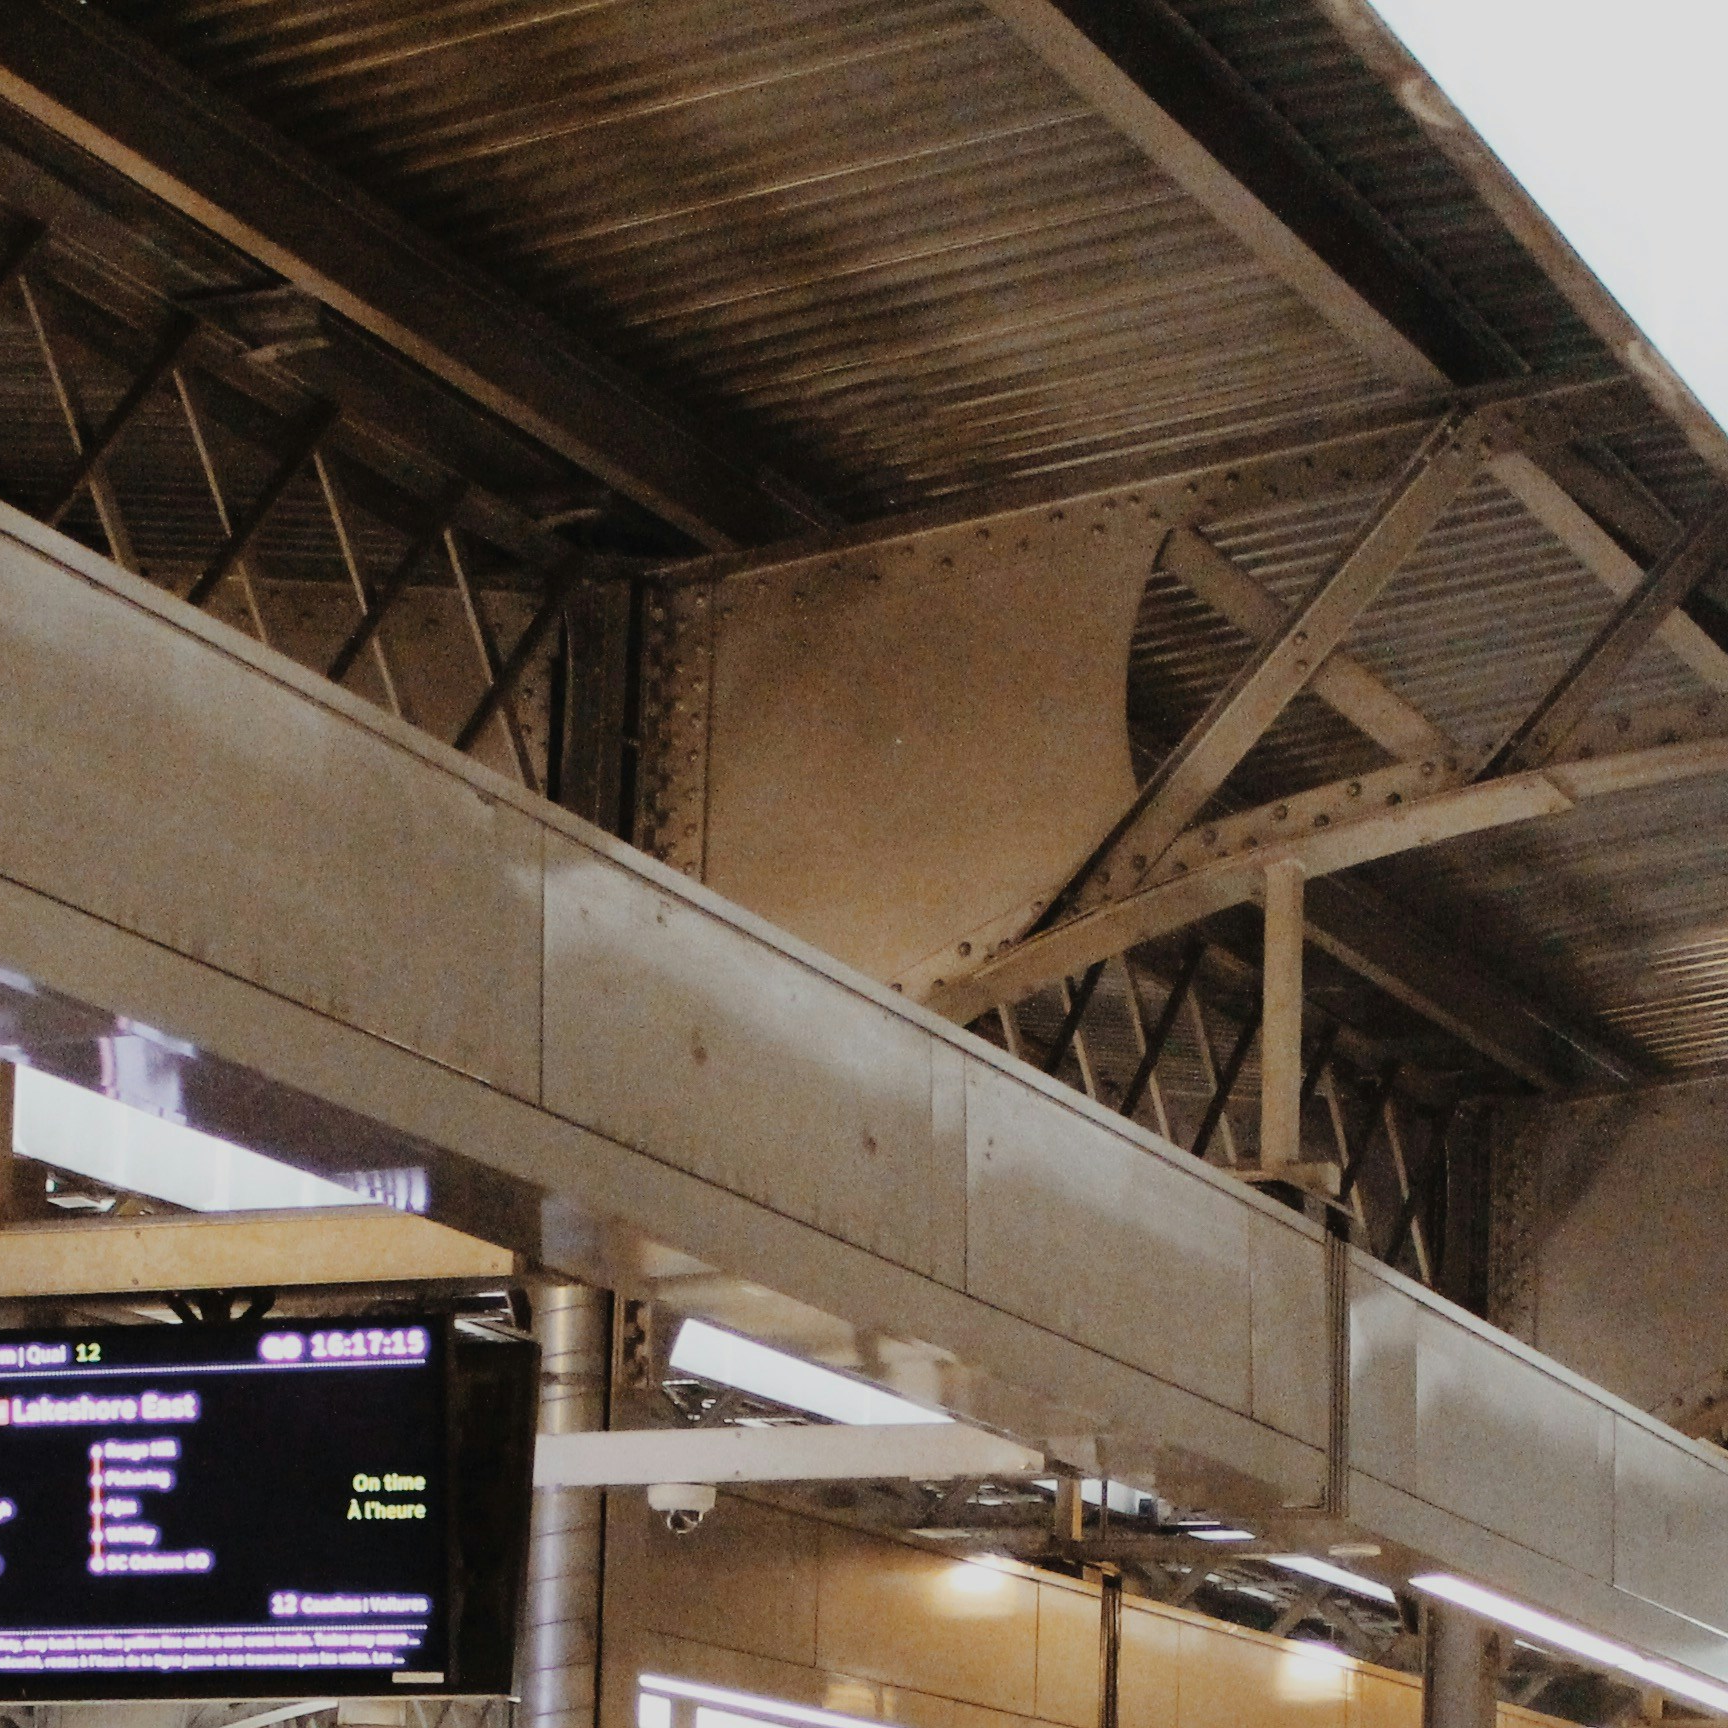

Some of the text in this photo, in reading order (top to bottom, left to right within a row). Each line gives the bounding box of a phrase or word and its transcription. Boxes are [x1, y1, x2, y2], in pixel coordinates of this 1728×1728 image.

[27, 1344, 67, 1364] Quai
[75, 1342, 101, 1362] 12
[311, 1329, 425, 1357] 16:17:15
[12, 1395, 137, 1423] Lakeshore
[140, 1391, 196, 1420] East
[352, 1472, 426, 1493] On time
[347, 1498, 426, 1520] À l'heure
